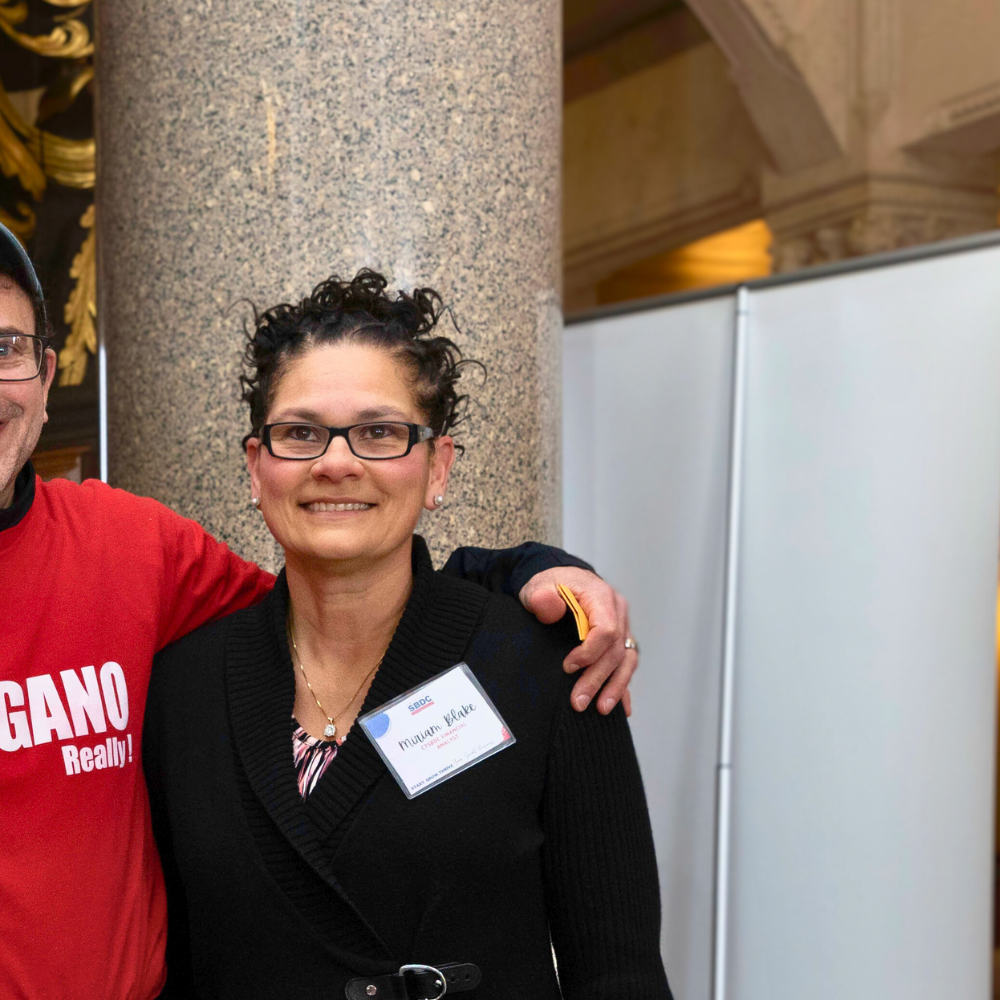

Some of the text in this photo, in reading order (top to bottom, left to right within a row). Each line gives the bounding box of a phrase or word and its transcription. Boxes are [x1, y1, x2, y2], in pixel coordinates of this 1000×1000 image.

[407, 695, 432, 712] SBDC
[398, 724, 442, 751] Miriam
[443, 703, 476, 727] Blake
[61, 734, 133, 776] Really!
